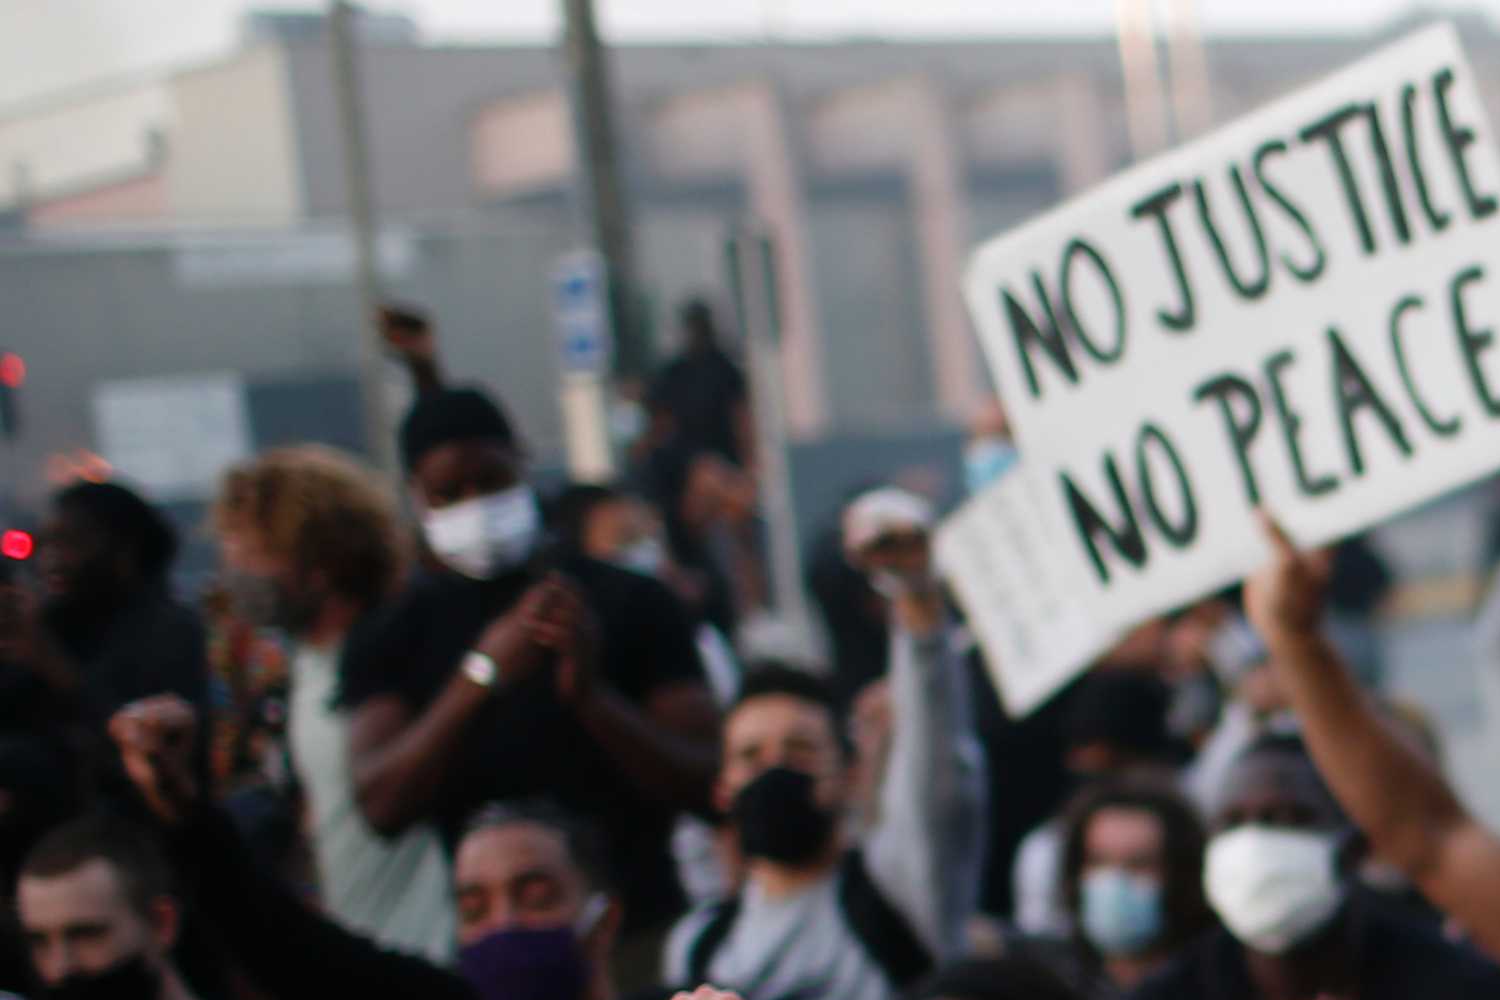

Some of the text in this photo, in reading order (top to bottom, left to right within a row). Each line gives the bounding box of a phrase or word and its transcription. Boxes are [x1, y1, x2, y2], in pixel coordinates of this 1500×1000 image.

[1000, 68, 1499, 400] NO JUSTICE
[1058, 419, 1198, 587] NO
